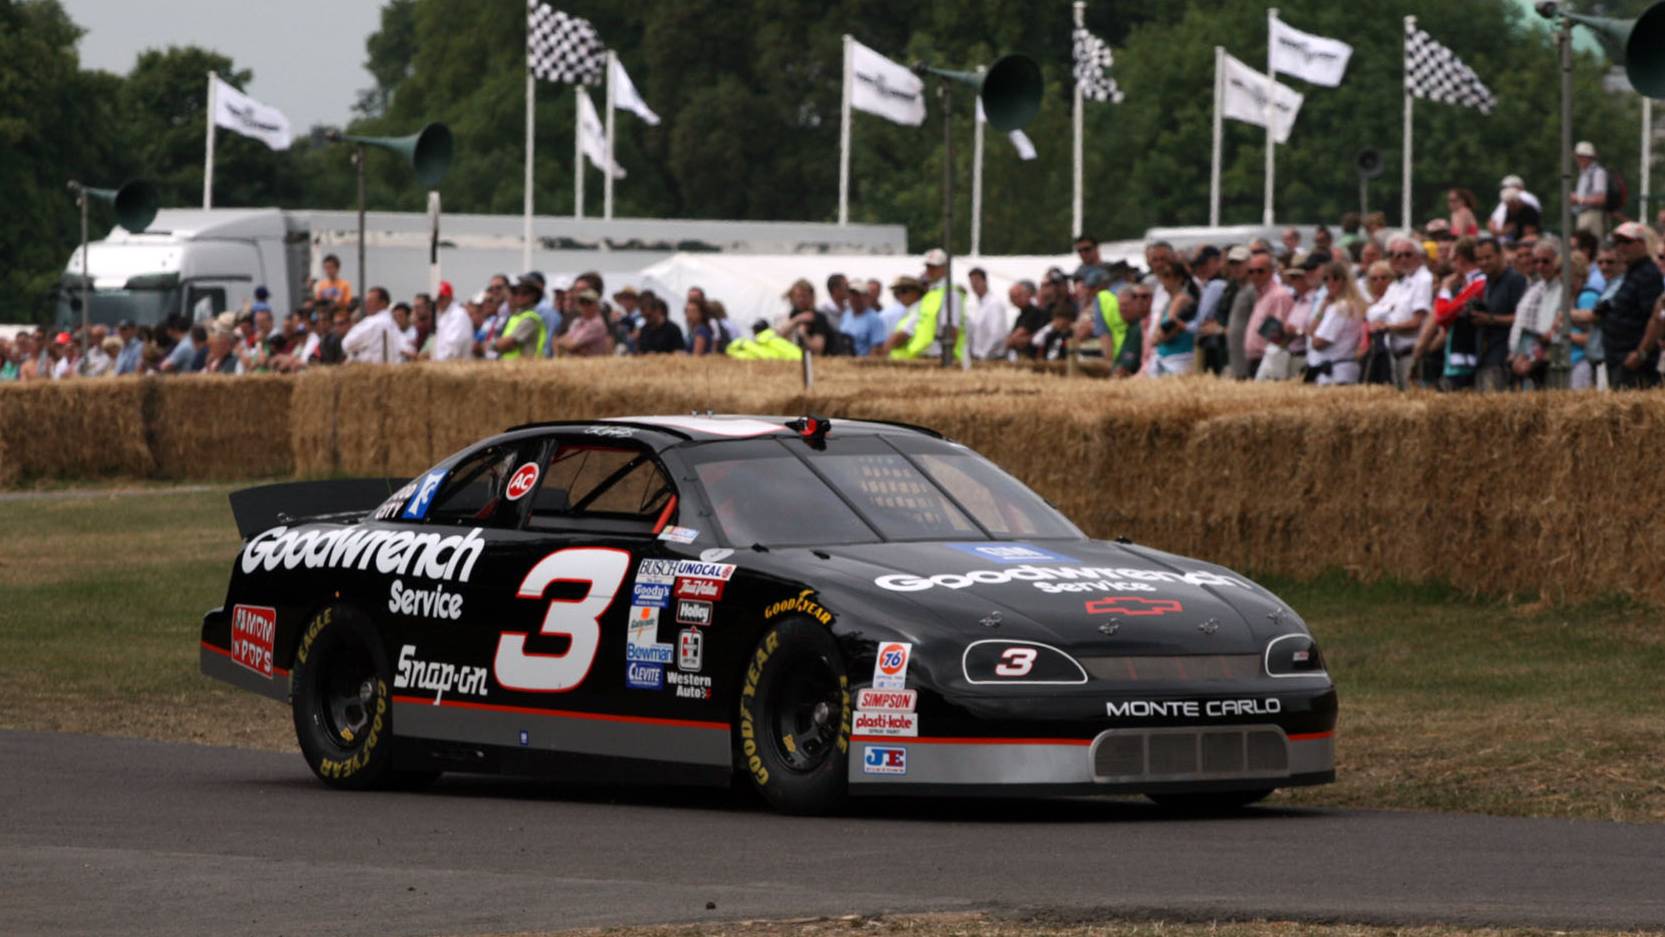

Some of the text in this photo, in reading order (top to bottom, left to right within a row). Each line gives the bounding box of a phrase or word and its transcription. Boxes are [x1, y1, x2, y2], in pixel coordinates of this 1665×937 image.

[511, 473, 534, 488] AC
[241, 525, 485, 582] Goodwrench
[640, 560, 678, 577] BUSCH
[679, 562, 721, 577] UNOCAL
[875, 564, 1252, 592] Goodwrench
[634, 584, 670, 598] Goody's
[1032, 581, 1157, 593] Service
[389, 579, 463, 619] Service
[764, 588, 833, 625] GOODYEAR
[493, 546, 632, 694] 3
[680, 603, 710, 623] Holley
[298, 607, 333, 664] EAGLE
[627, 643, 672, 661] Bowman
[883, 651, 902, 667] 76
[629, 662, 660, 681] CLEVITE
[995, 647, 1038, 677] 3
[394, 644, 489, 706] Snap-on
[667, 671, 711, 686] Western
[676, 685, 701, 698] Auto
[861, 691, 912, 709] SIMPSON
[740, 631, 780, 785] GOODYEAR
[1106, 698, 1281, 717] MONTE CARLO
[856, 713, 913, 729] plasti-kote
[866, 748, 905, 767] JE
